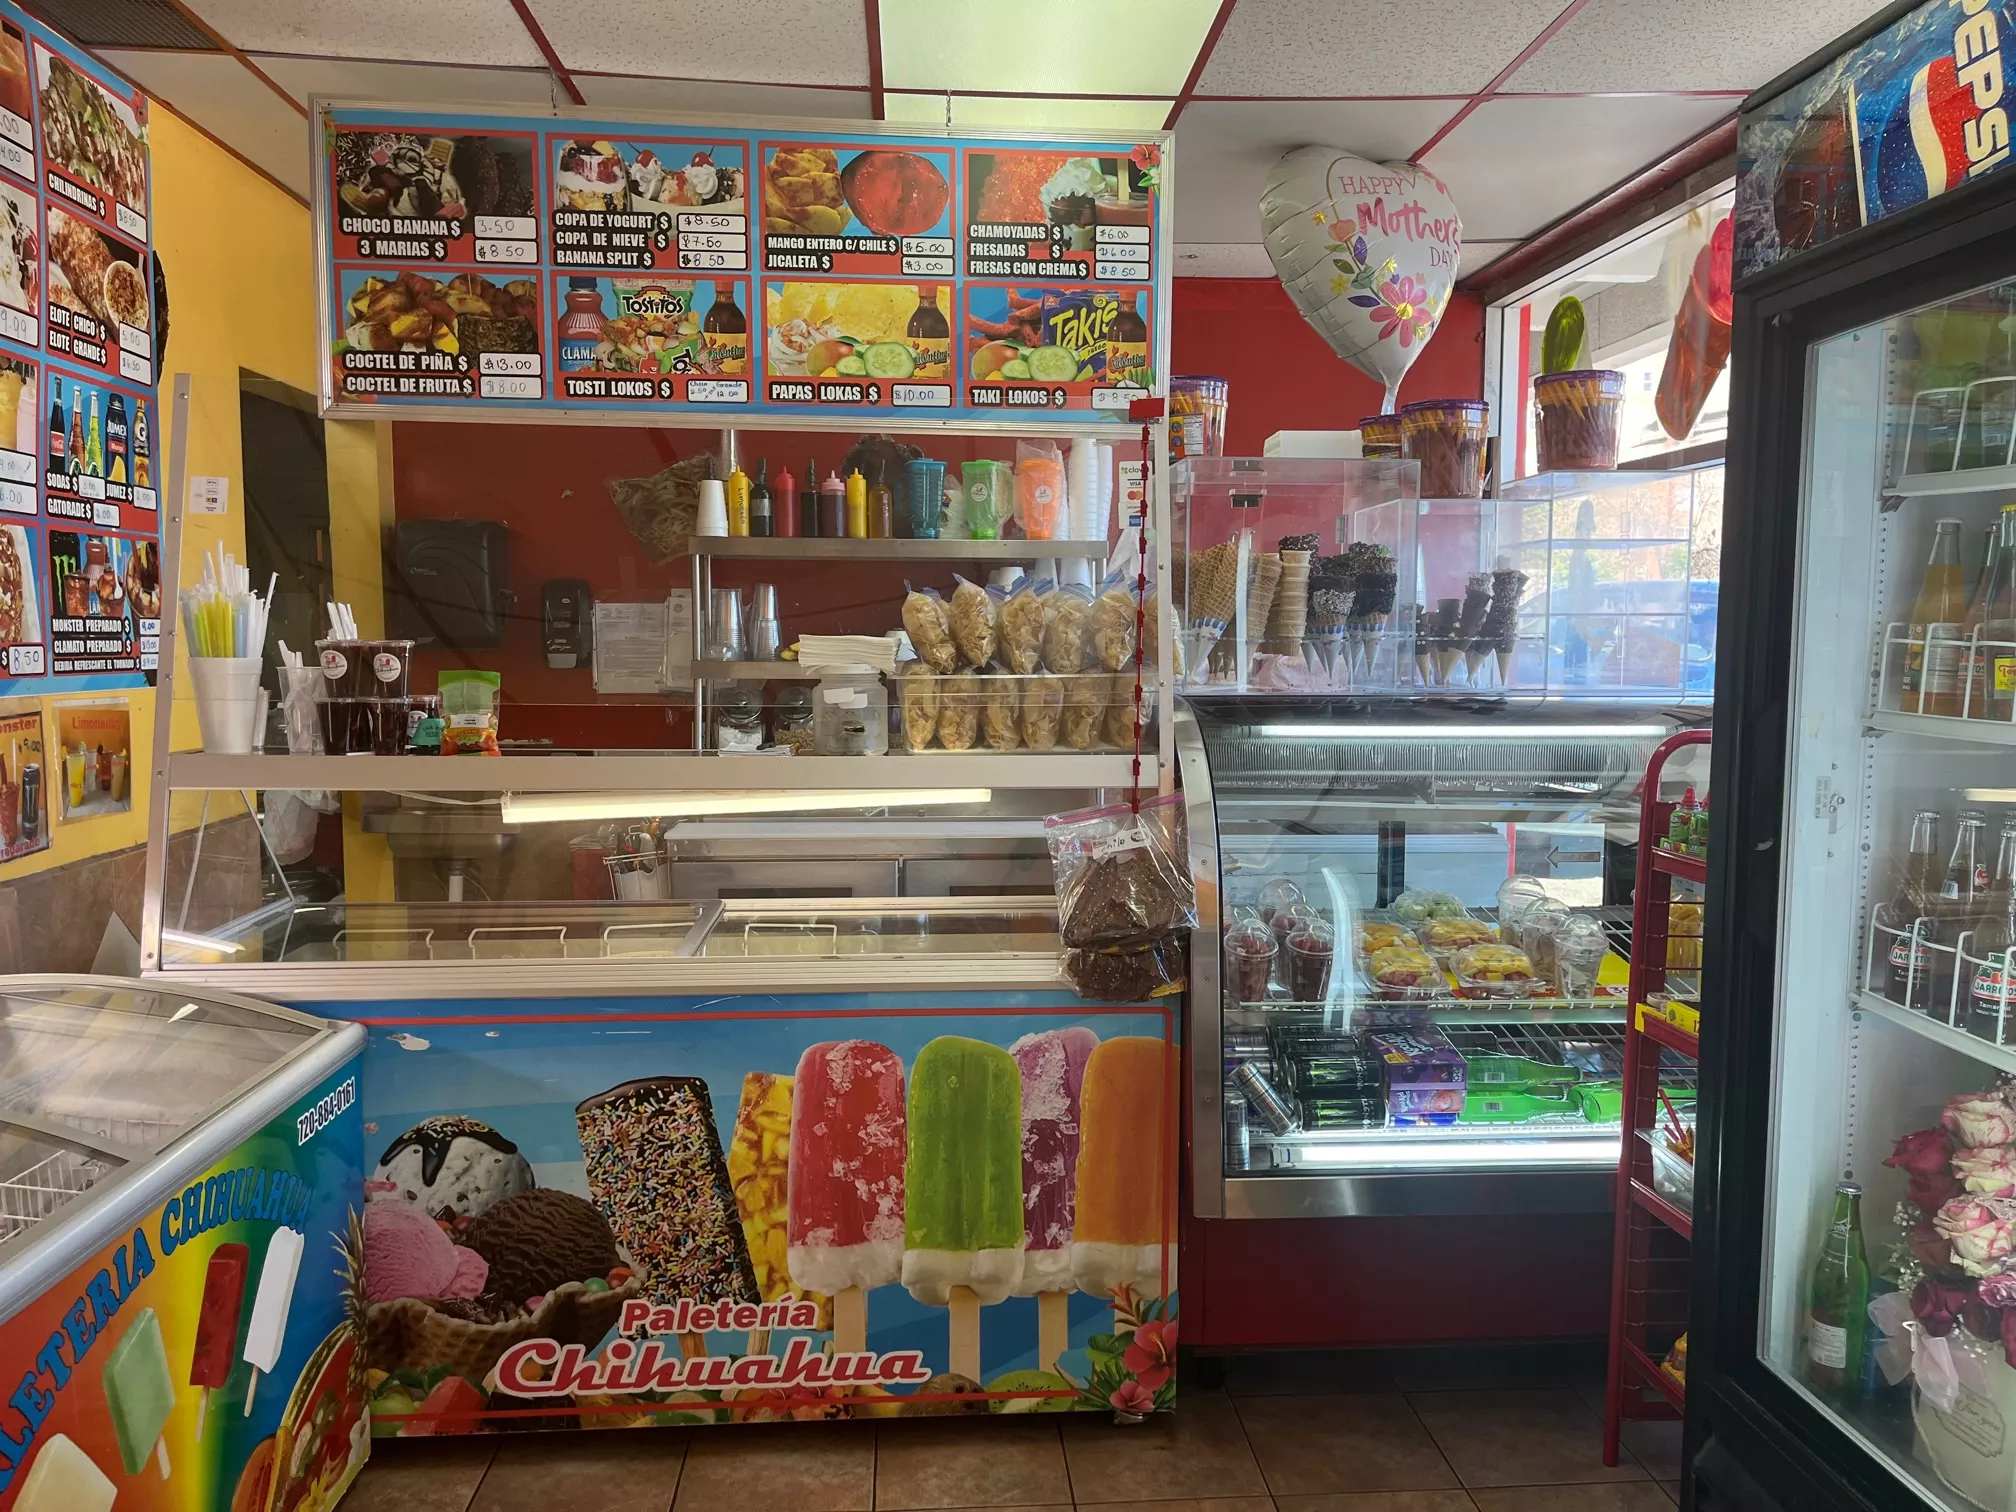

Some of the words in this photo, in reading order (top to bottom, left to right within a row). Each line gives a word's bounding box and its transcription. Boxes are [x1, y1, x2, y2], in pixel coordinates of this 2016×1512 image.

[48, 172, 97, 212] CHILINDRINAS
[100, 200, 106, 217] $
[1338, 176, 1408, 195] HAPPY
[342, 217, 389, 234] CHOCO
[393, 218, 448, 236] BANANA
[450, 220, 461, 237] $
[555, 213, 586, 226] COPA
[590, 214, 604, 227] DE
[606, 214, 652, 229] YOGURT
[660, 215, 668, 230] $
[556, 232, 588, 246] COPA
[593, 232, 608, 246] DE
[612, 233, 646, 247] NIEVE
[657, 233, 666, 249] $
[970, 224, 1046, 240] CHAMOYADAS
[1052, 226, 1061, 241] $
[360, 240, 370, 255] 3
[376, 240, 430, 257] MARIAS
[434, 241, 445, 259] $
[768, 237, 804, 250] MANGO
[806, 238, 842, 250] ENTERO
[845, 238, 857, 251] C/
[859, 239, 887, 251] CHILE
[888, 239, 896, 253] $
[970, 243, 1026, 257] FRESADAS
[1052, 244, 1061, 259] $
[556, 250, 604, 265] BANANA
[606, 252, 639, 266] SPLIT
[643, 252, 652, 267] $
[768, 254, 818, 269] JICALETA
[822, 256, 831, 270] $
[970, 262, 1011, 275] FRESAS
[1012, 262, 1036, 276] CON
[1038, 262, 1077, 276] CREMA
[1078, 263, 1087, 277] $
[50, 305, 70, 327] ELOTE
[74, 314, 94, 336] CHICO
[100, 324, 106, 342] $
[50, 330, 70, 352] ELOTE
[74, 338, 100, 362] GRANDE
[100, 348, 106, 365] $
[345, 354, 396, 370] COCTEL
[398, 355, 416, 370] DE
[421, 352, 454, 371] PIÑA
[458, 355, 468, 372] $
[346, 376, 398, 392] COCTEL
[400, 377, 416, 392] DE
[418, 378, 461, 393] FRUTA
[462, 378, 473, 395] $
[567, 380, 606, 396] TOSTI
[610, 380, 652, 396] LOKOS
[660, 382, 670, 398] $
[772, 384, 813, 400] PAPAS
[820, 385, 862, 400] LOKAS
[868, 386, 878, 402] $
[972, 389, 1000, 404] TAKI
[1008, 390, 1048, 405] LOKOS
[1054, 390, 1064, 406] $
[46, 472, 70, 490] SODAS
[72, 478, 78, 492] $
[106, 483, 126, 500] JUMEZ
[128, 487, 132, 502] $
[48, 498, 85, 518] GATORADE
[86, 504, 92, 520] $
[52, 618, 84, 632] MONSTER
[86, 620, 122, 632] PREPARADO
[124, 620, 130, 632] $
[54, 640, 84, 654] CLAMATO
[86, 640, 122, 653] PREPARADO
[126, 640, 131, 653] $
[0, 718, 37, 733] nster
[0, 836, 40, 858] reparado
[297, 1076, 356, 1147] 720-884-0161
[619, 1294, 819, 1335] Paletería
[0, 1227, 156, 1494] LETERIA
[160, 1166, 313, 1258] CHIHUAHUA
[496, 1337, 931, 1395] Chihuahua
